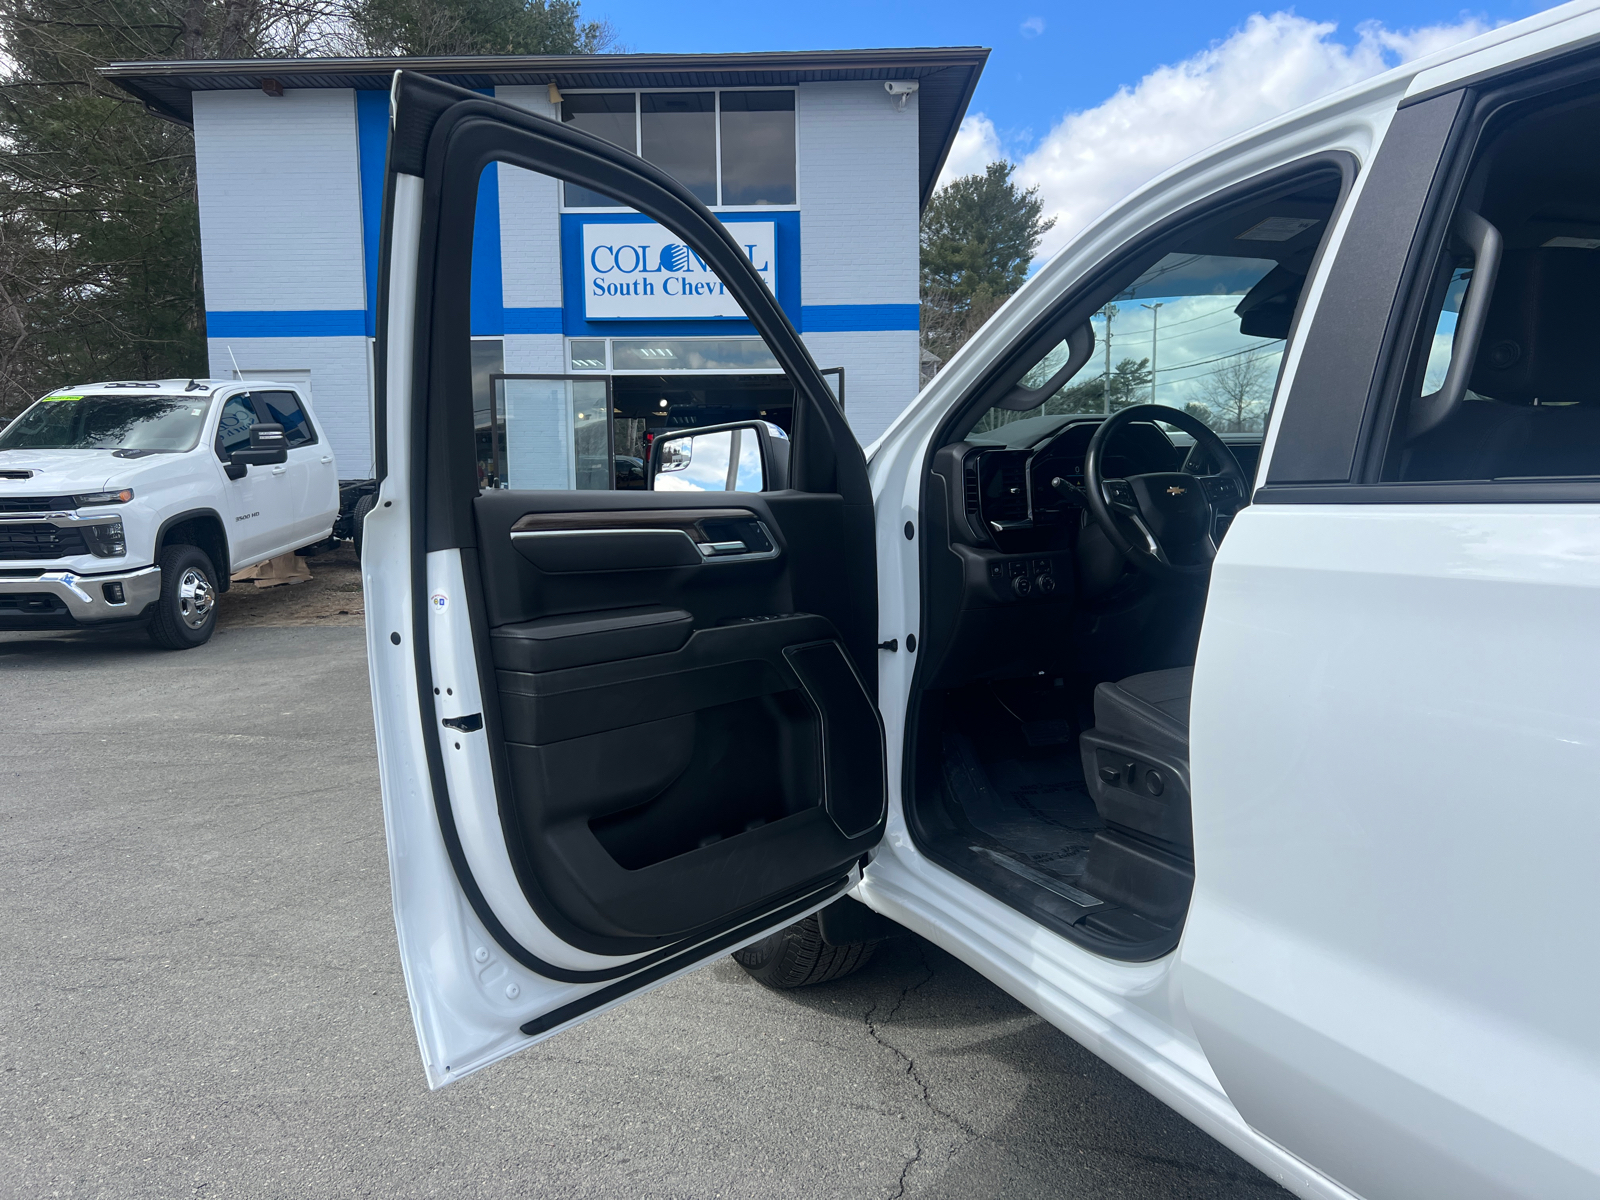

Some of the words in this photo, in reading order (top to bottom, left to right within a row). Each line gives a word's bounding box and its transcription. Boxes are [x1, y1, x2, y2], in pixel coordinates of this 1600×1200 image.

[590, 244, 769, 274] COLONL
[592, 277, 655, 296] South
[662, 276, 768, 296] Chevr
